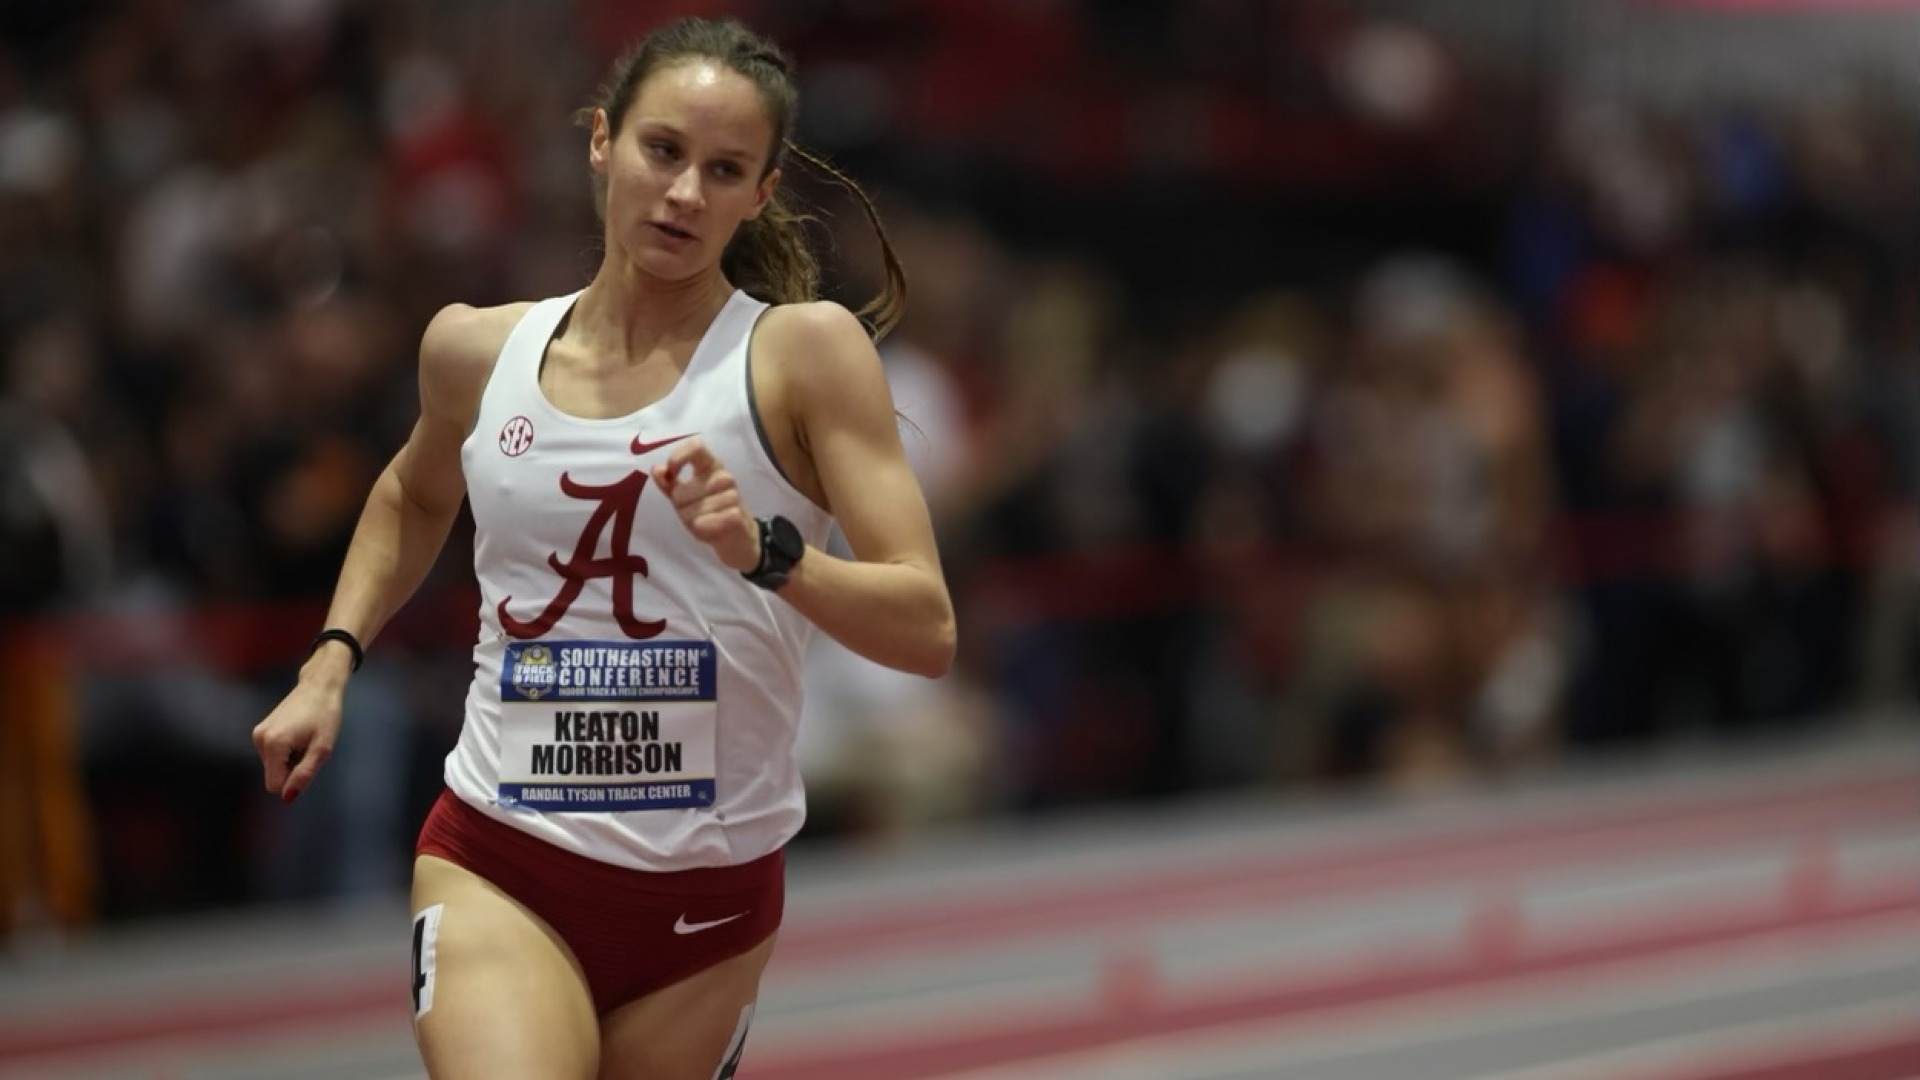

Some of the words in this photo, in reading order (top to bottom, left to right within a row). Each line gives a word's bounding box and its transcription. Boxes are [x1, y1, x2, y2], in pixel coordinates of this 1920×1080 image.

[500, 416, 533, 456] SEC
[498, 470, 667, 639] A
[560, 648, 699, 667] SOUTHEASTERN
[515, 665, 553, 674] TRACK
[524, 674, 554, 683] FIELD
[559, 668, 700, 686] CONFERENCE
[559, 687, 585, 696] INDOOR
[587, 687, 610, 696] TRACK
[618, 687, 637, 696] FIELD
[638, 687, 700, 696] CHAMPIONSHIPS
[555, 711, 659, 742] KEATON
[531, 742, 682, 776] MORRISON
[521, 787, 565, 802] RANDAL
[567, 787, 604, 802] TYSON
[607, 786, 646, 801] TRACK
[648, 784, 691, 799] CENTER
